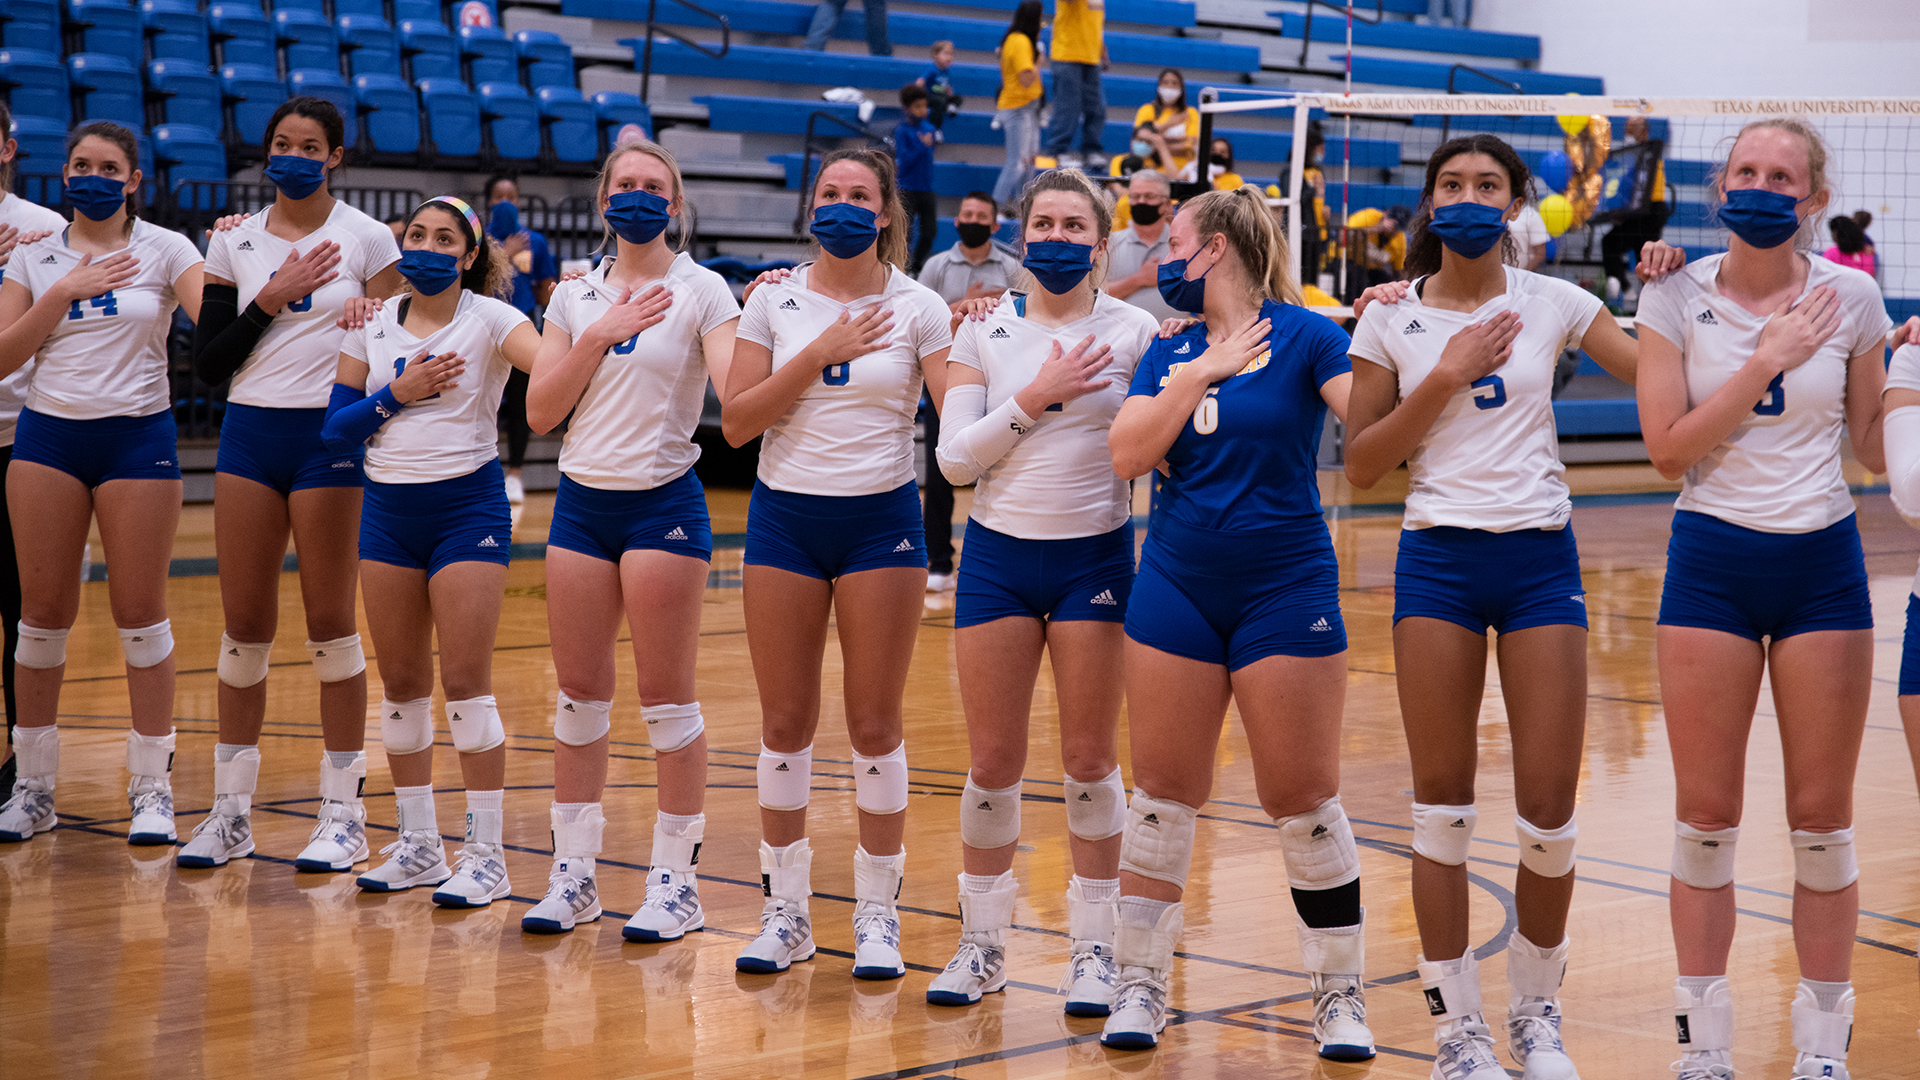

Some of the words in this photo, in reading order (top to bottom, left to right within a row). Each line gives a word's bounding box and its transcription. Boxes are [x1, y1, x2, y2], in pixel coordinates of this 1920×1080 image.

[1366, 98, 1394, 110] A&M
[1396, 98, 1548, 112] UNIVERSITY-KINGSVILLE
[1712, 100, 1753, 114] TEXAS
[1756, 100, 1788, 114] A&M
[1193, 387, 1220, 435] 6
